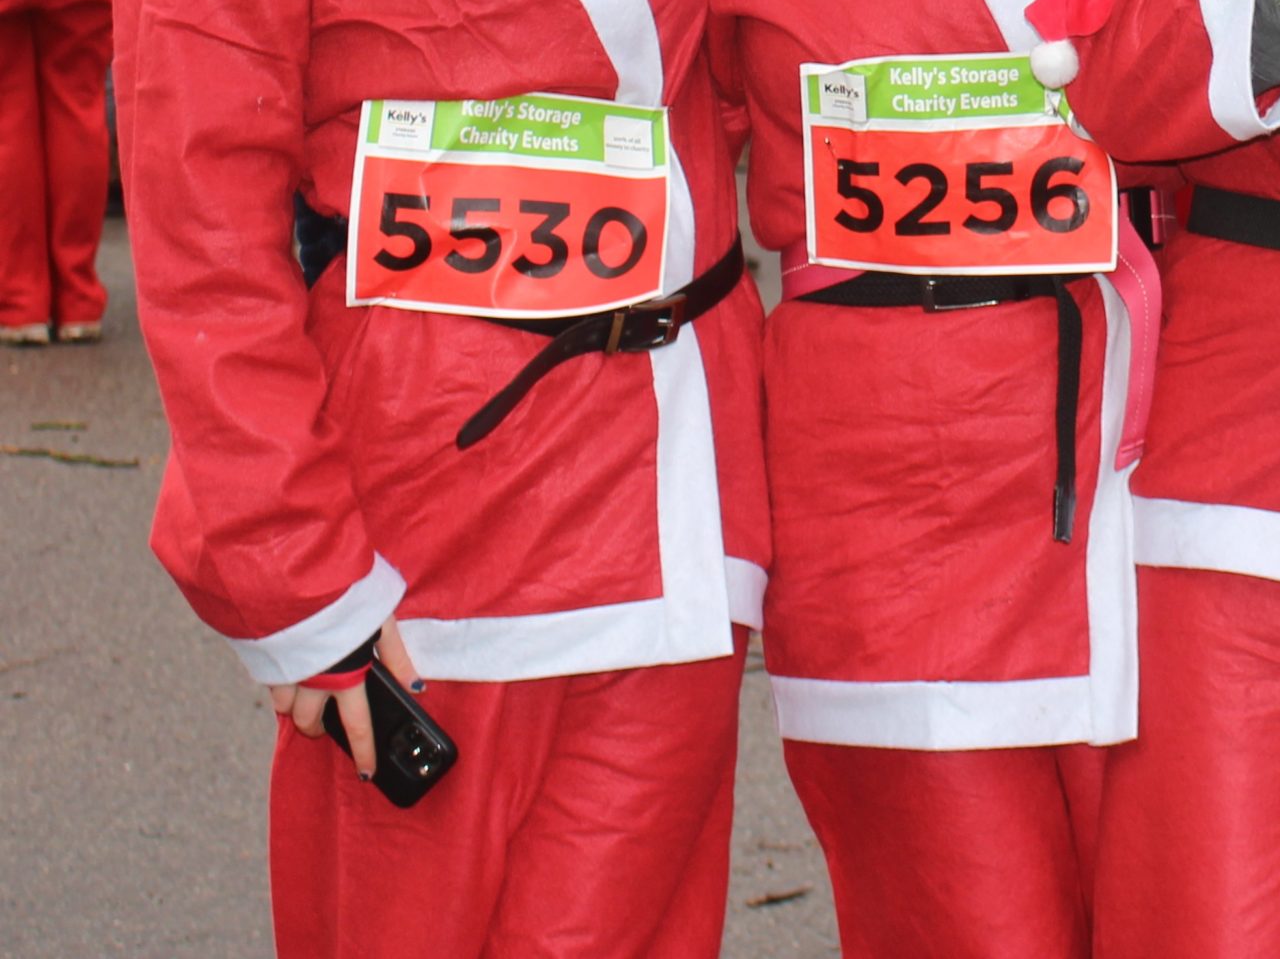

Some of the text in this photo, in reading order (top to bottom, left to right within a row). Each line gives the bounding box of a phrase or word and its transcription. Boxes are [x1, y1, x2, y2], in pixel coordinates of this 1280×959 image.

[824, 83, 859, 98] Kelly's
[890, 66, 1019, 90] Kelly's Storage
[461, 100, 582, 129] Kelly's Storage
[892, 92, 1018, 116] Charity Events
[387, 109, 427, 126] Kelly's
[459, 126, 579, 152] Charity Events
[834, 156, 1090, 236] 5256
[373, 192, 648, 279] 5530
